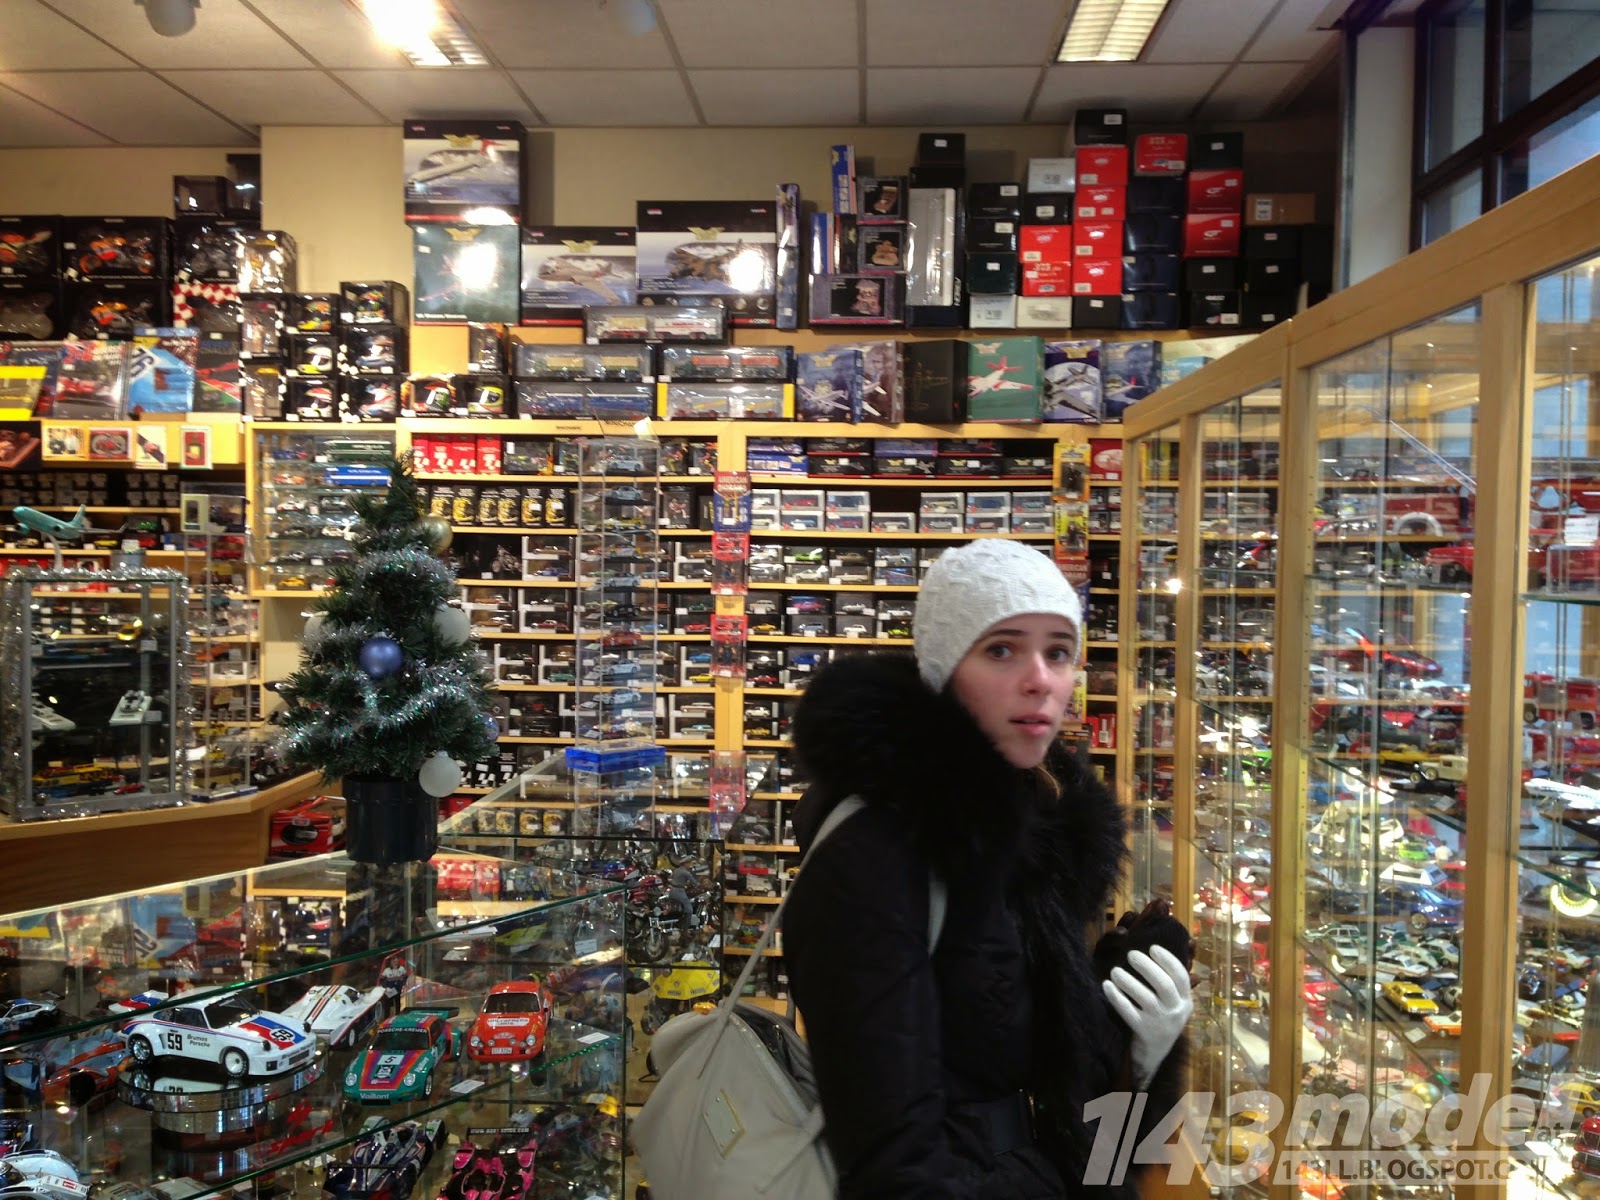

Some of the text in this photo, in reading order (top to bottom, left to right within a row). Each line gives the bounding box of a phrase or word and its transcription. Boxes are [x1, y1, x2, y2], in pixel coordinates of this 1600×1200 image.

[272, 1029, 293, 1041] 59
[167, 1033, 183, 1050] 59
[189, 1040, 211, 1048] Porsche
[384, 1055, 397, 1064] 5
[360, 1092, 390, 1100] Vaillant
